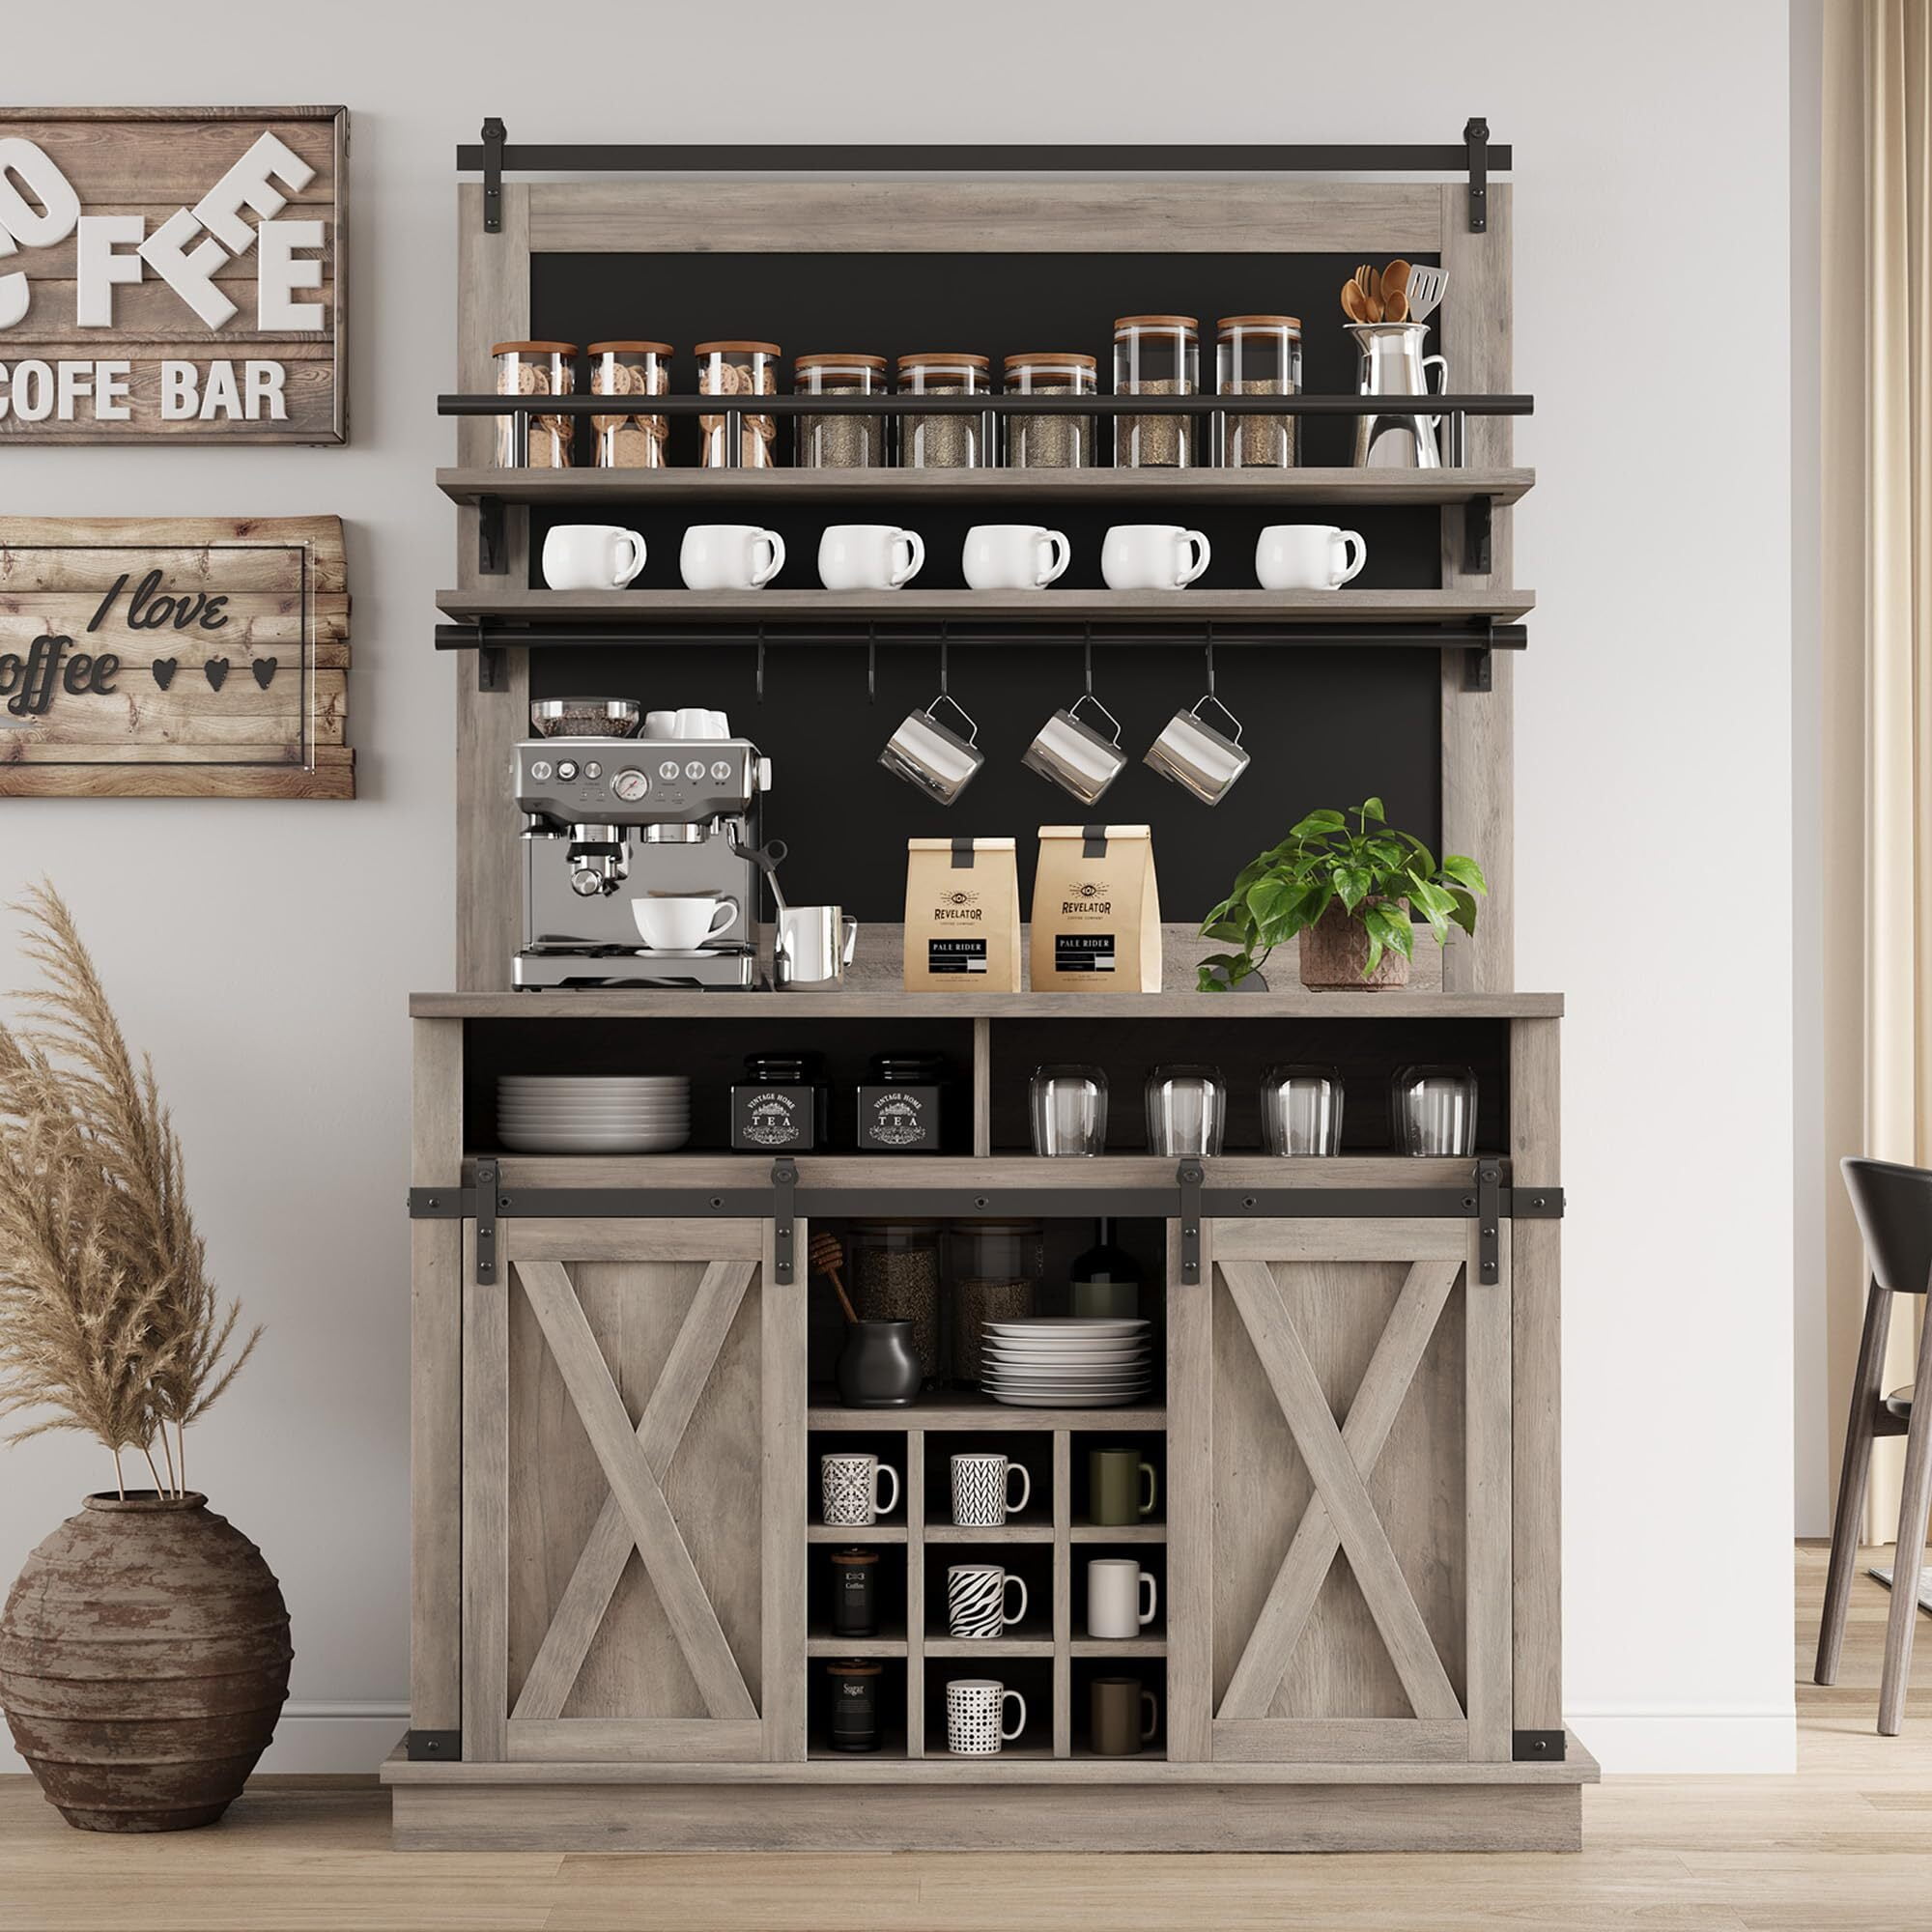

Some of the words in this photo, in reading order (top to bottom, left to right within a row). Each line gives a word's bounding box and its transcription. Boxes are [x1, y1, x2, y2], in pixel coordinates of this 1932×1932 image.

[0, 359, 131, 421] OFE
[161, 360, 289, 420] BAR
[87, 574, 129, 633] I
[128, 569, 229, 630] love
[934, 908, 982, 920] REVELATOR
[1062, 901, 1112, 915] REVELATOR
[748, 1094, 776, 1109] VINTAGE
[777, 1094, 796, 1110] HOME
[873, 1094, 901, 1109] VINTAGE
[903, 1094, 923, 1110] HOME
[752, 1116, 791, 1126] TEA
[878, 1116, 918, 1126] TEA
[843, 1683, 865, 1696] Sugar
